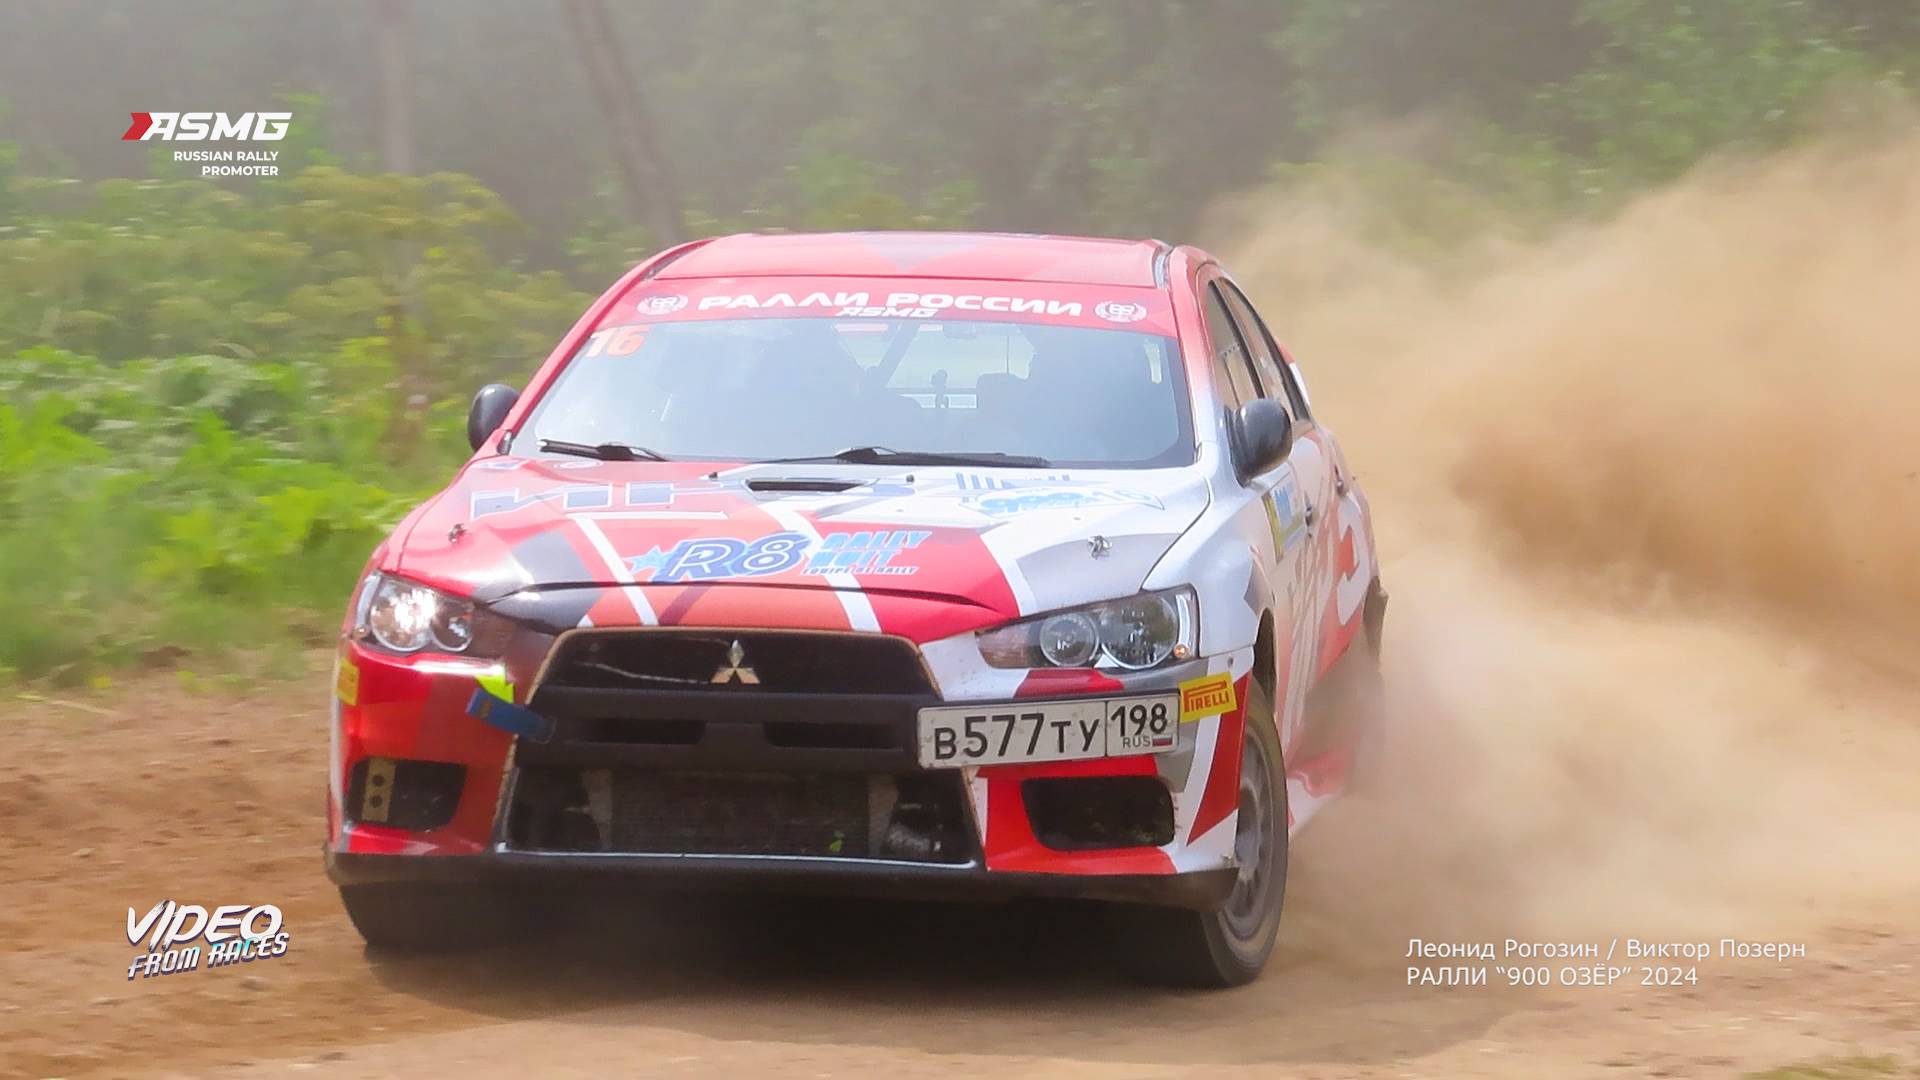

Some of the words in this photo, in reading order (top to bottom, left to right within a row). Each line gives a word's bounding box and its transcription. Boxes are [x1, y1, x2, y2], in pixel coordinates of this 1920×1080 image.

[698, 292, 869, 310] РАЛЛИ
[887, 292, 1082, 317] РОССИИ
[585, 325, 646, 357] 16
[822, 530, 932, 549] RALLY
[655, 532, 809, 582] R8
[1183, 680, 1230, 713] PIRELLI
[934, 713, 1100, 760] В577ТУ
[1110, 703, 1167, 736] 198
[1122, 736, 1150, 749] RUS
